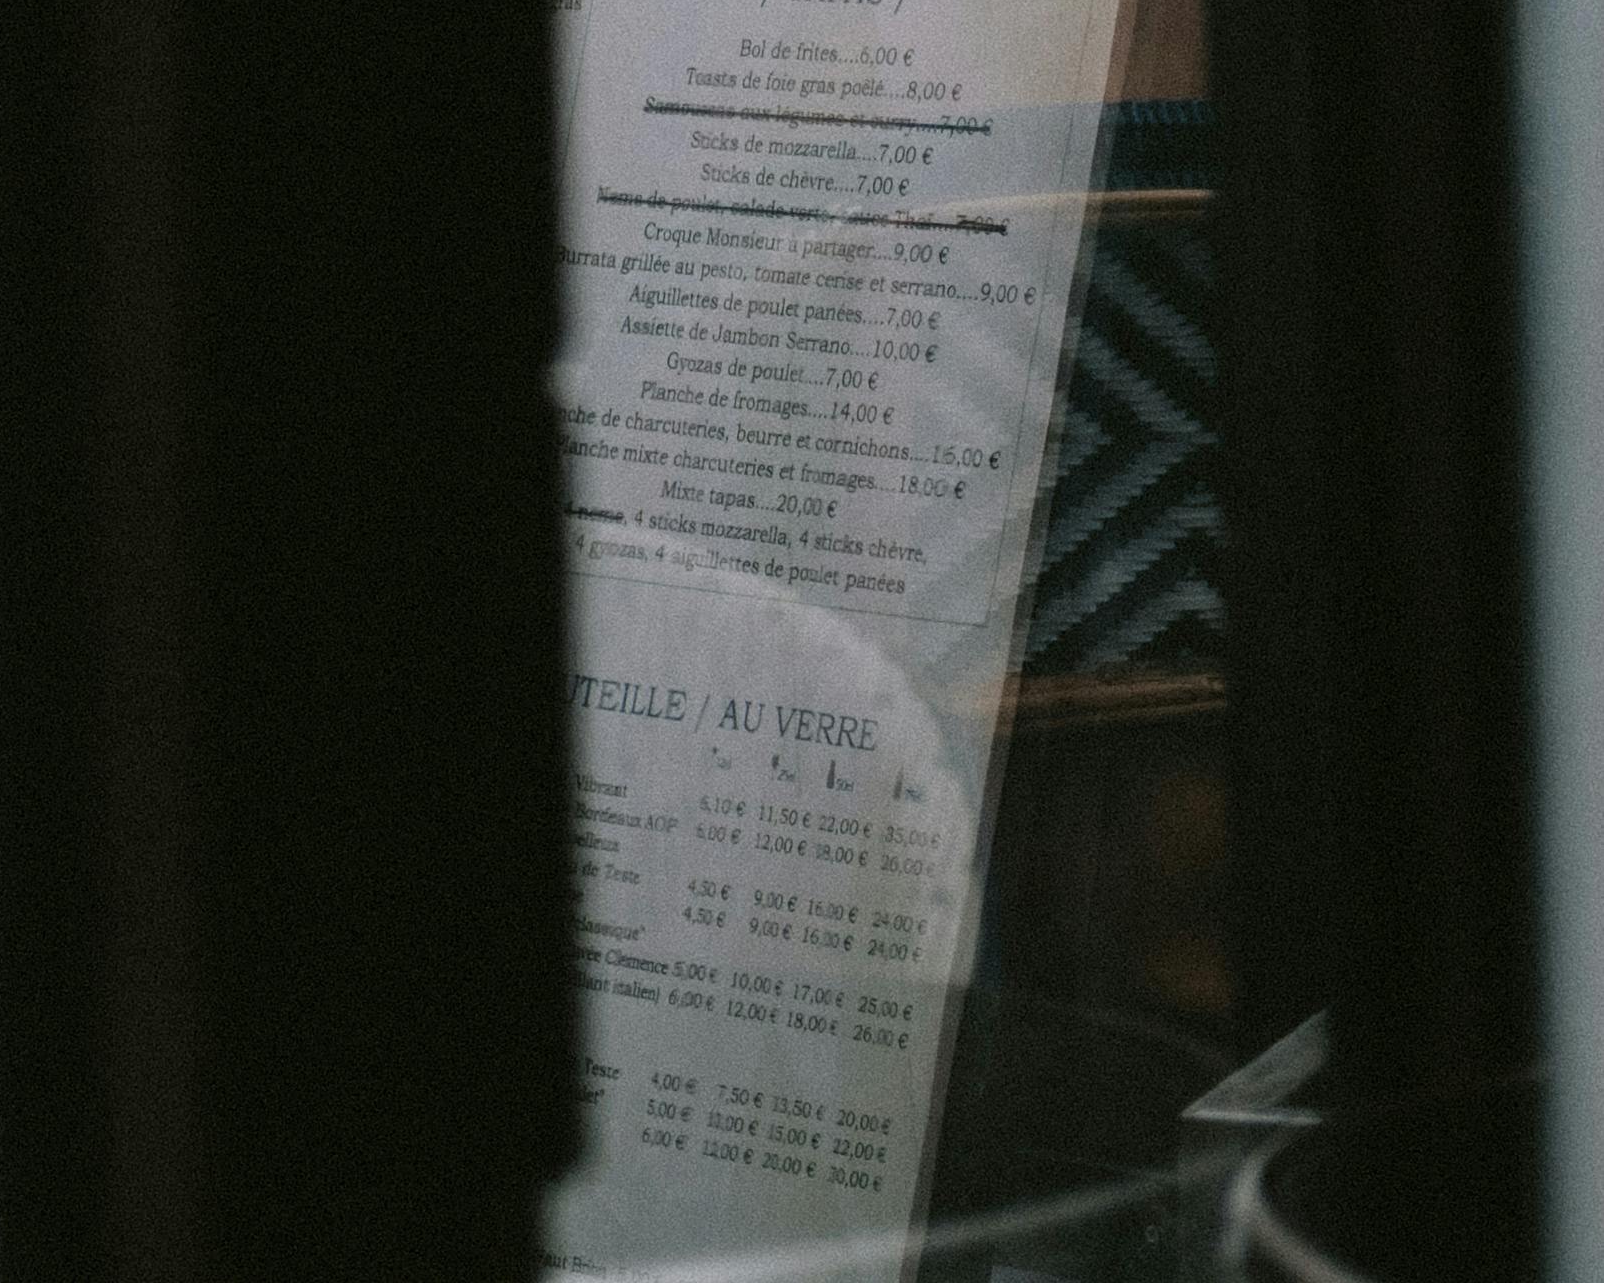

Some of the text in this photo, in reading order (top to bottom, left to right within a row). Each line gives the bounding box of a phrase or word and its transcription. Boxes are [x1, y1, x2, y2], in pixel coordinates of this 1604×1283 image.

[740, 39, 766, 59] Bol
[771, 40, 791, 60] de
[686, 68, 737, 89] Toasts
[742, 70, 761, 90] de
[766, 72, 795, 92] foie
[800, 80, 835, 98] gras
[690, 131, 739, 152] Sticks
[744, 134, 763, 154] de
[700, 162, 750, 184] Sticks
[755, 166, 774, 186] de
[643, 222, 702, 250] Croque
[706, 228, 782, 252] Monsieur
[621, 250, 670, 277] grillée
[674, 261, 695, 275] au
[700, 257, 747, 284] pesto,
[754, 262, 811, 285] tomate
[816, 268, 864, 290] cerise
[869, 272, 886, 292] et
[629, 286, 719, 316] Aiguillettes
[723, 293, 743, 313] de
[747, 295, 799, 322] poulet
[621, 315, 685, 339] Assiette
[689, 321, 708, 341] de
[713, 324, 780, 348] Jambon
[666, 352, 722, 380] Gyozas
[727, 358, 747, 378] de
[640, 380, 704, 405] Planche
[708, 387, 729, 407] de
[602, 409, 621, 430] de
[625, 413, 728, 445] charcuteries,
[736, 423, 791, 447] beurre
[796, 429, 811, 449] et
[623, 443, 668, 466] mixte
[673, 449, 773, 478] charcuteries
[779, 460, 794, 480] et
[661, 482, 704, 504] Mixte
[634, 508, 644, 528] 4
[649, 510, 696, 534] sticks
[701, 517, 792, 551] mozzarella,
[799, 528, 809, 548] 4
[813, 531, 863, 555] sticks
[868, 537, 927, 567] chèvre,
[655, 544, 665, 564] 4
[764, 558, 783, 579] de
[788, 562, 839, 591] poulet
[845, 569, 905, 599] panées
[718, 698, 766, 734] AU
[776, 705, 878, 752] VERRE
[758, 805, 798, 827] 11,50
